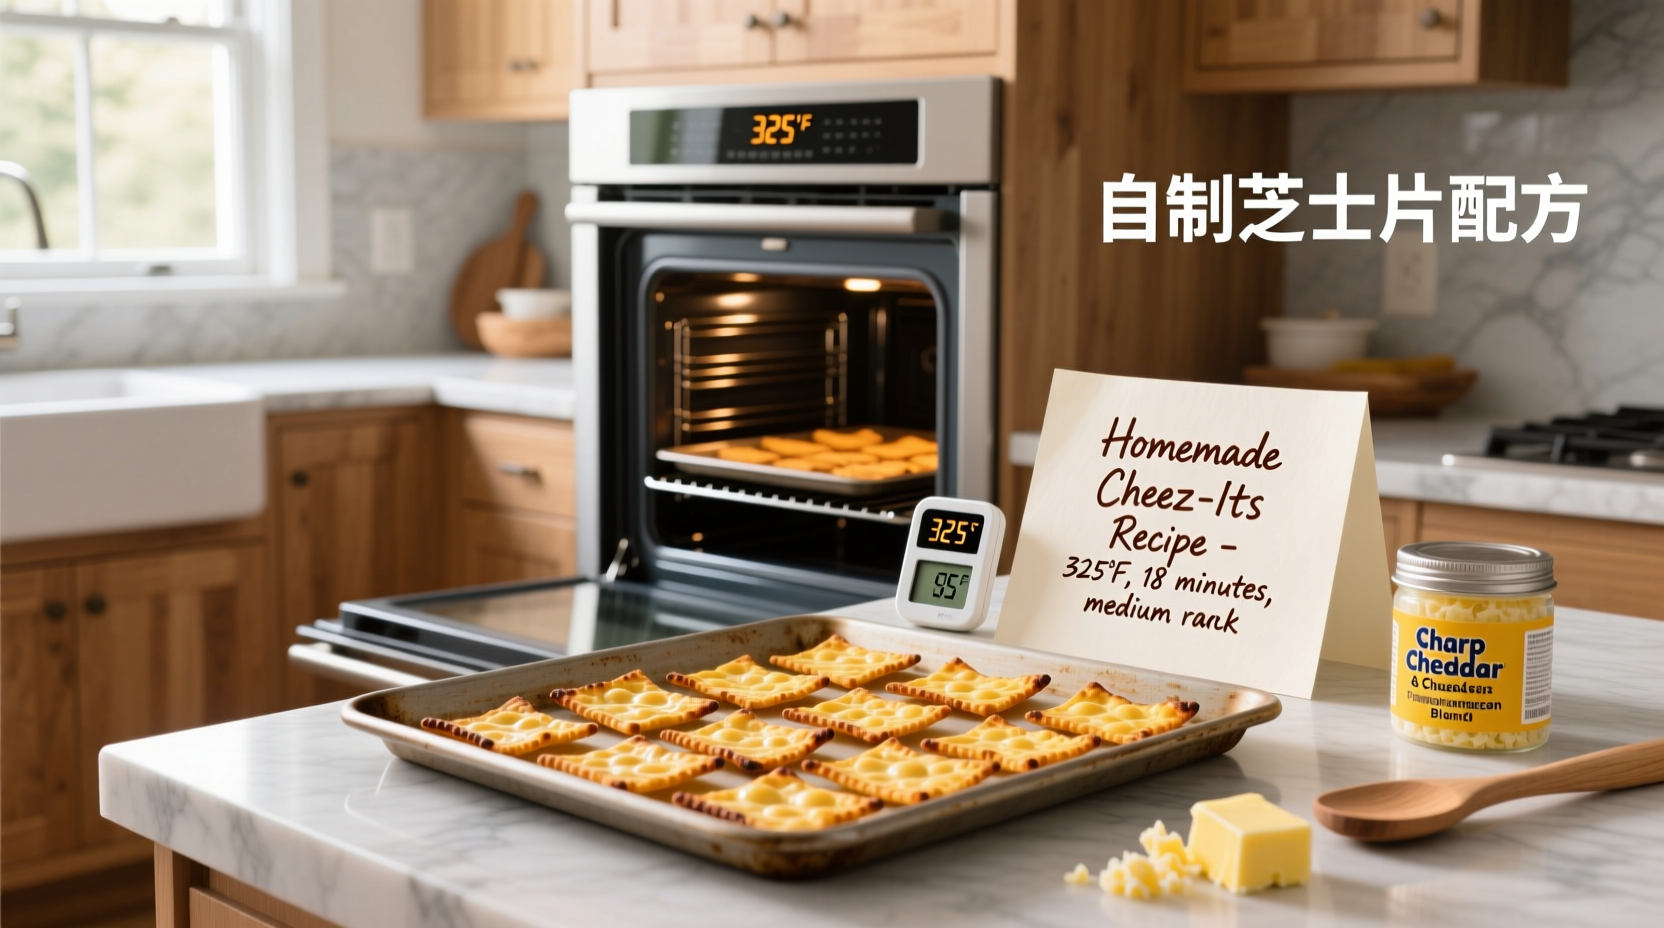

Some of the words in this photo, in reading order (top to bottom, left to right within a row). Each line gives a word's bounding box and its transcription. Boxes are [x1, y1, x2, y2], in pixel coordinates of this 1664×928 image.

[1101, 416, 1283, 470] Homemade
[1096, 467, 1265, 520] Cheez-Its
[1109, 515, 1208, 568] Recipe
[1062, 556, 1132, 590] 325°F,
[1143, 566, 1168, 590] 18
[1174, 572, 1272, 609] minutes,
[1083, 593, 1171, 624] medium
[1406, 650, 1504, 679] Cheddar
[1416, 627, 1486, 662] Charp
